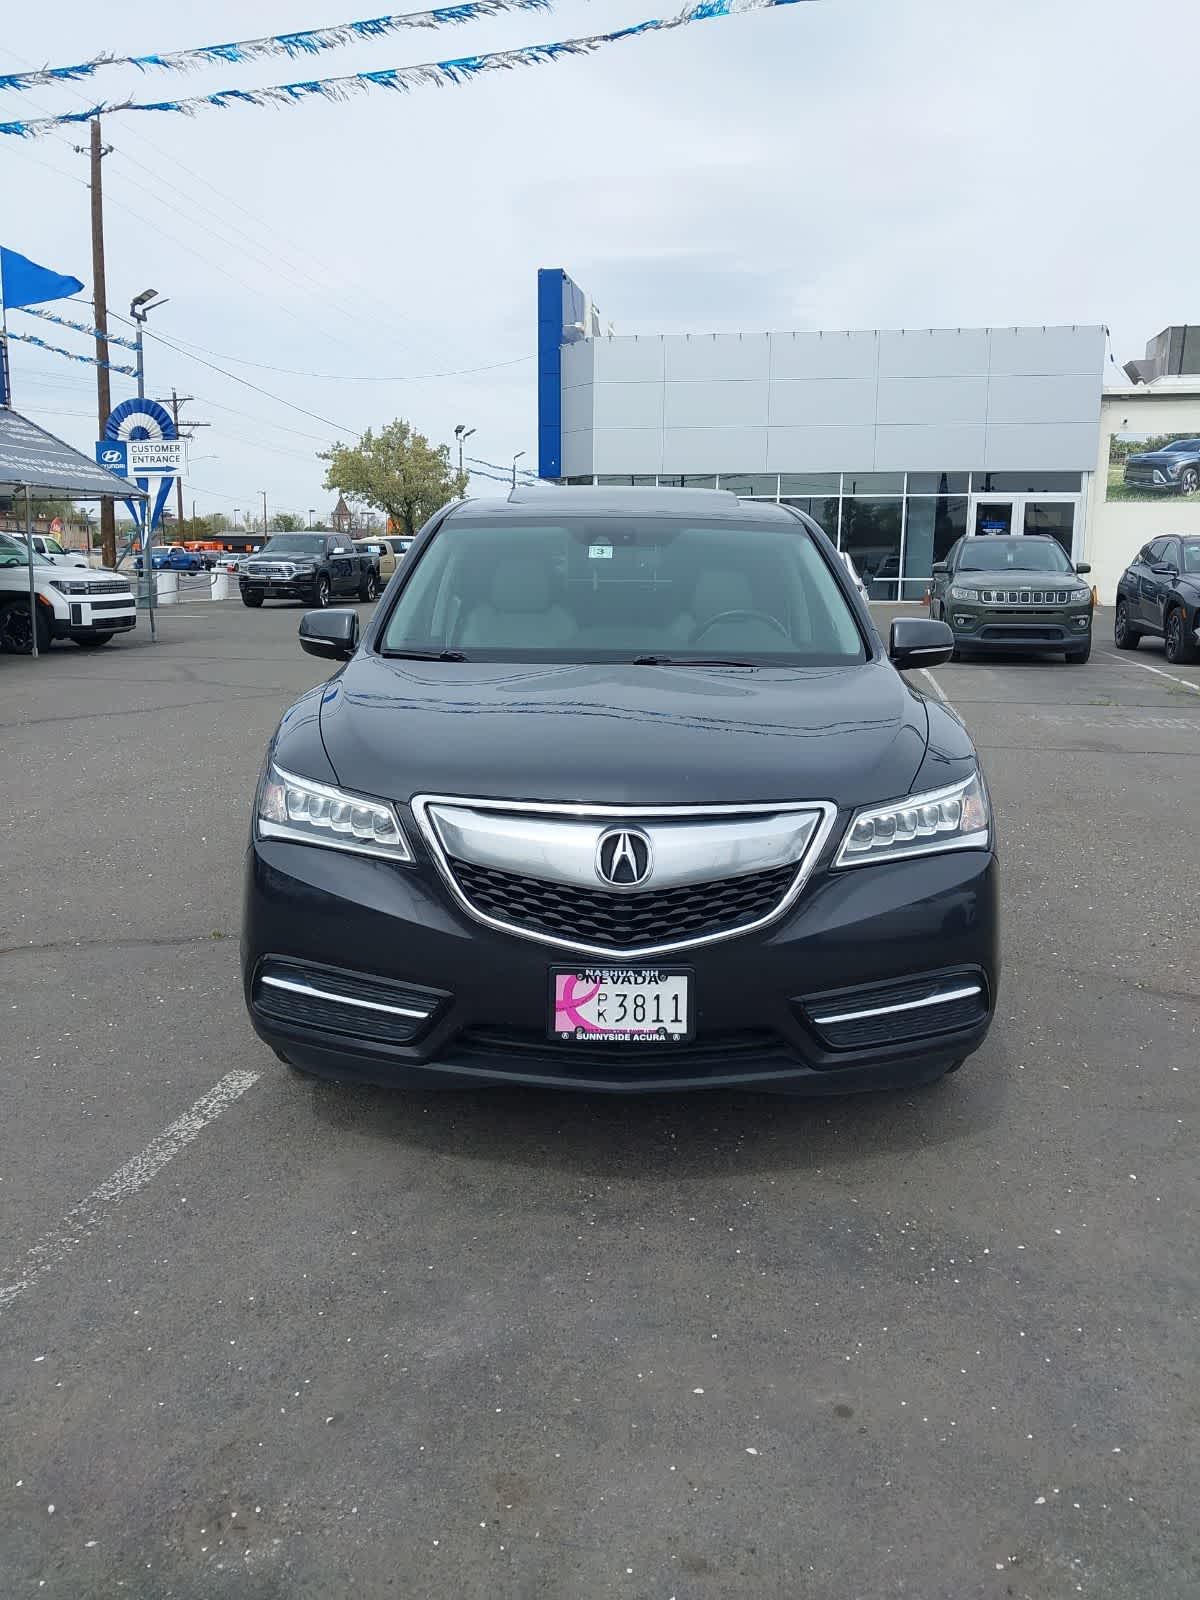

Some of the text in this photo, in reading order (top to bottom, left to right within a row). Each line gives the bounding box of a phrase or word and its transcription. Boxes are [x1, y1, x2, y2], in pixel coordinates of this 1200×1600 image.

[131, 444, 181, 453] CUSTOMER
[132, 455, 181, 463] ENTRANCE
[615, 993, 683, 1023] 3811
[576, 1033, 666, 1041] SUNNYSIDE ACURA
